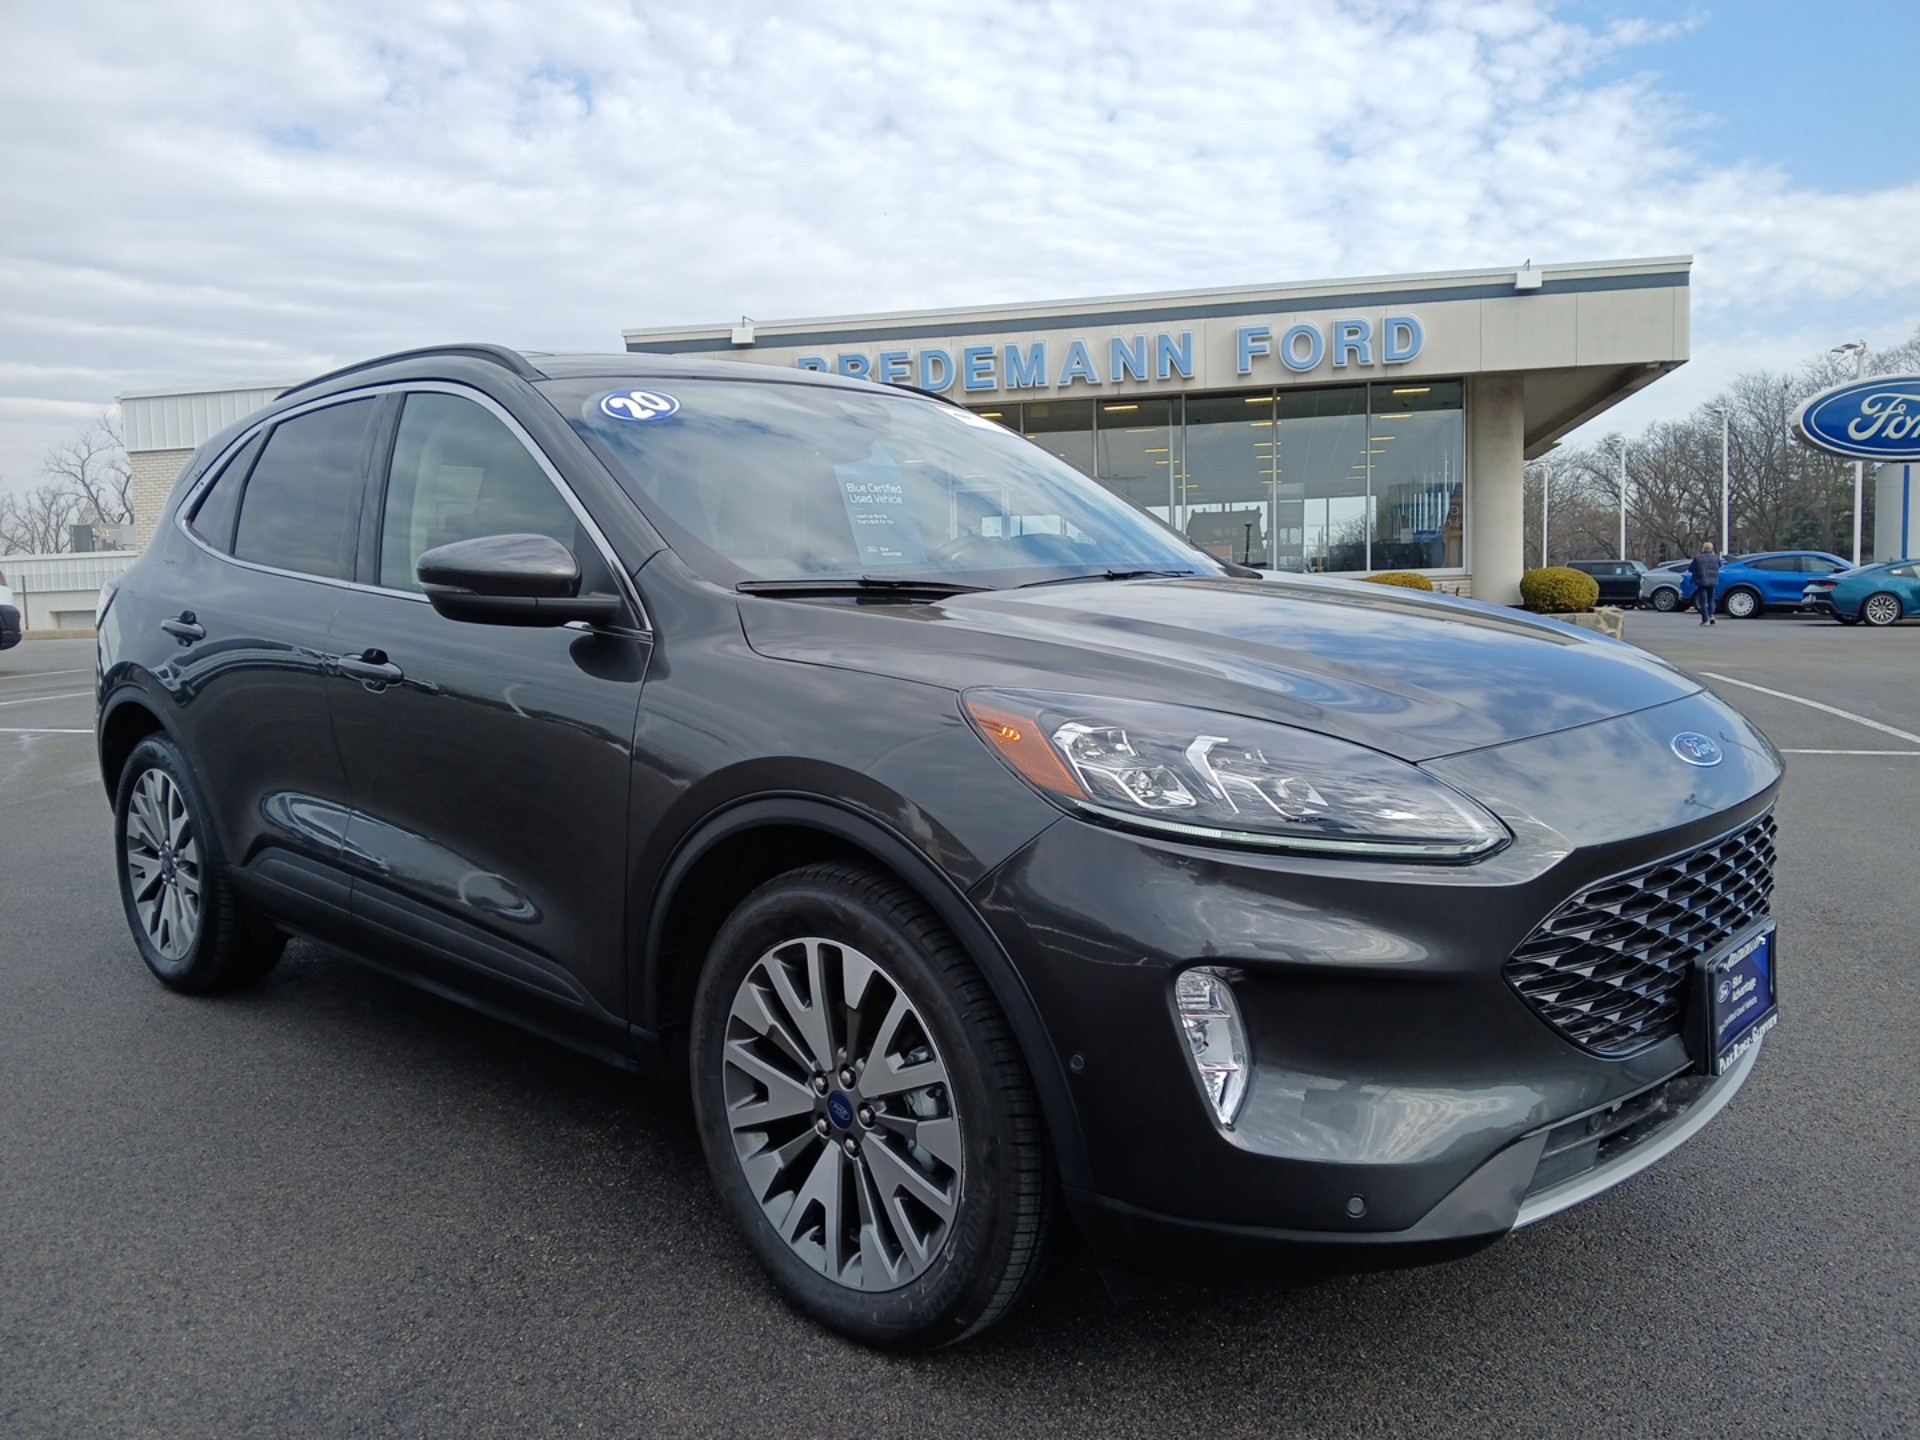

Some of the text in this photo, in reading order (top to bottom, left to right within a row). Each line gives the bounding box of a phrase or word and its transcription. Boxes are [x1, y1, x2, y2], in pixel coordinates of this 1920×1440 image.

[1236, 313, 1425, 375] FORD
[608, 391, 671, 419] 20
[846, 482, 902, 494] Blue Certified
[849, 493, 903, 505] Used Vehicle
